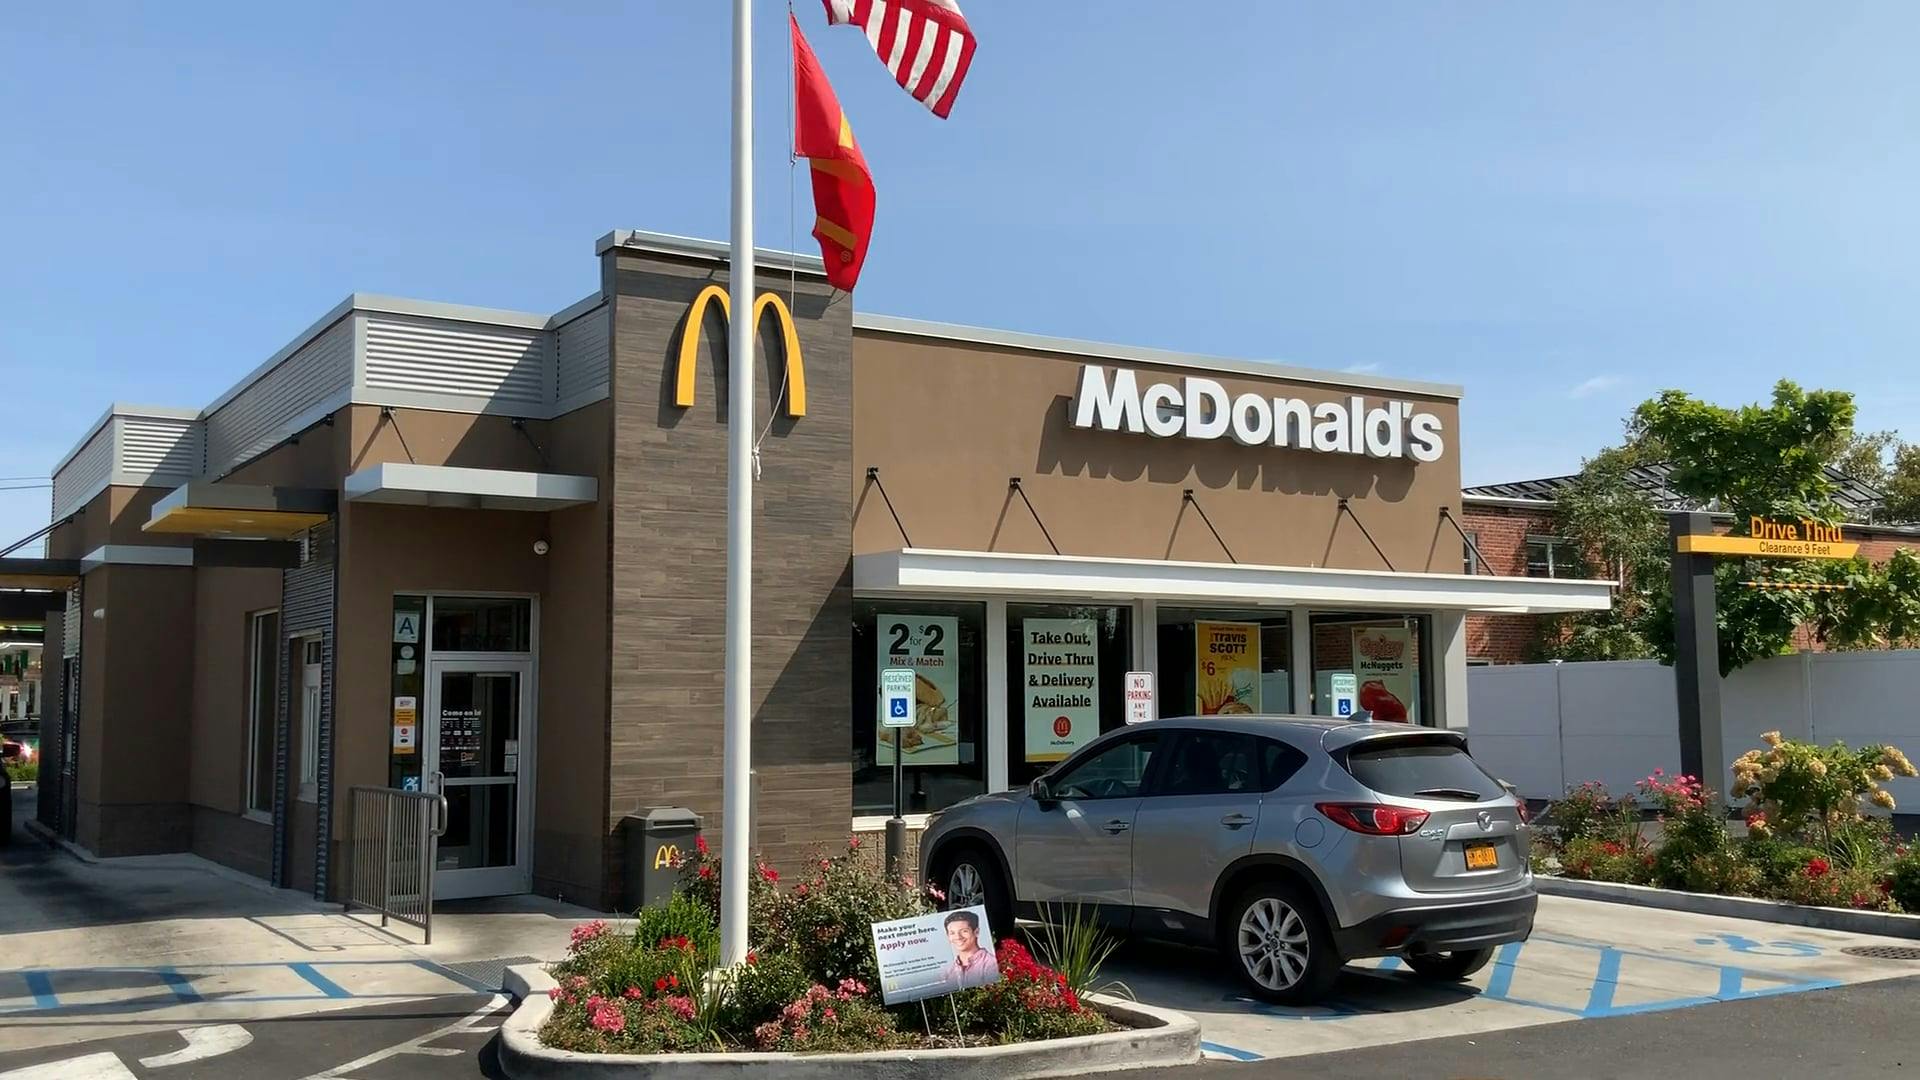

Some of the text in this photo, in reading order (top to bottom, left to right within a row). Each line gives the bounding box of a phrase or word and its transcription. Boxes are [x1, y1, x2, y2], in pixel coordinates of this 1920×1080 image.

[1074, 364, 1444, 462] McDonald's
[1751, 516, 1844, 543] Drive Thru
[1759, 541, 1832, 556] Clearance 9 Feet
[398, 616, 414, 634] A
[889, 623, 910, 655] 2
[910, 635, 922, 646] for
[1030, 631, 1091, 646] Take Out,
[1214, 632, 1247, 643] Travis
[1210, 643, 1247, 654] SCOTT
[890, 657, 944, 667] Mix & Match
[1028, 651, 1094, 666] Drive Thru
[1360, 661, 1404, 671] McNuggets
[887, 684, 912, 692] PARKING
[1029, 673, 1094, 689] & Delivery
[1134, 679, 1145, 688] NO
[1032, 694, 1091, 708] Available
[1127, 690, 1151, 700] PARKING
[877, 923, 916, 934] Make your
[896, 930, 917, 938] move
[880, 937, 929, 951] Apply now.
